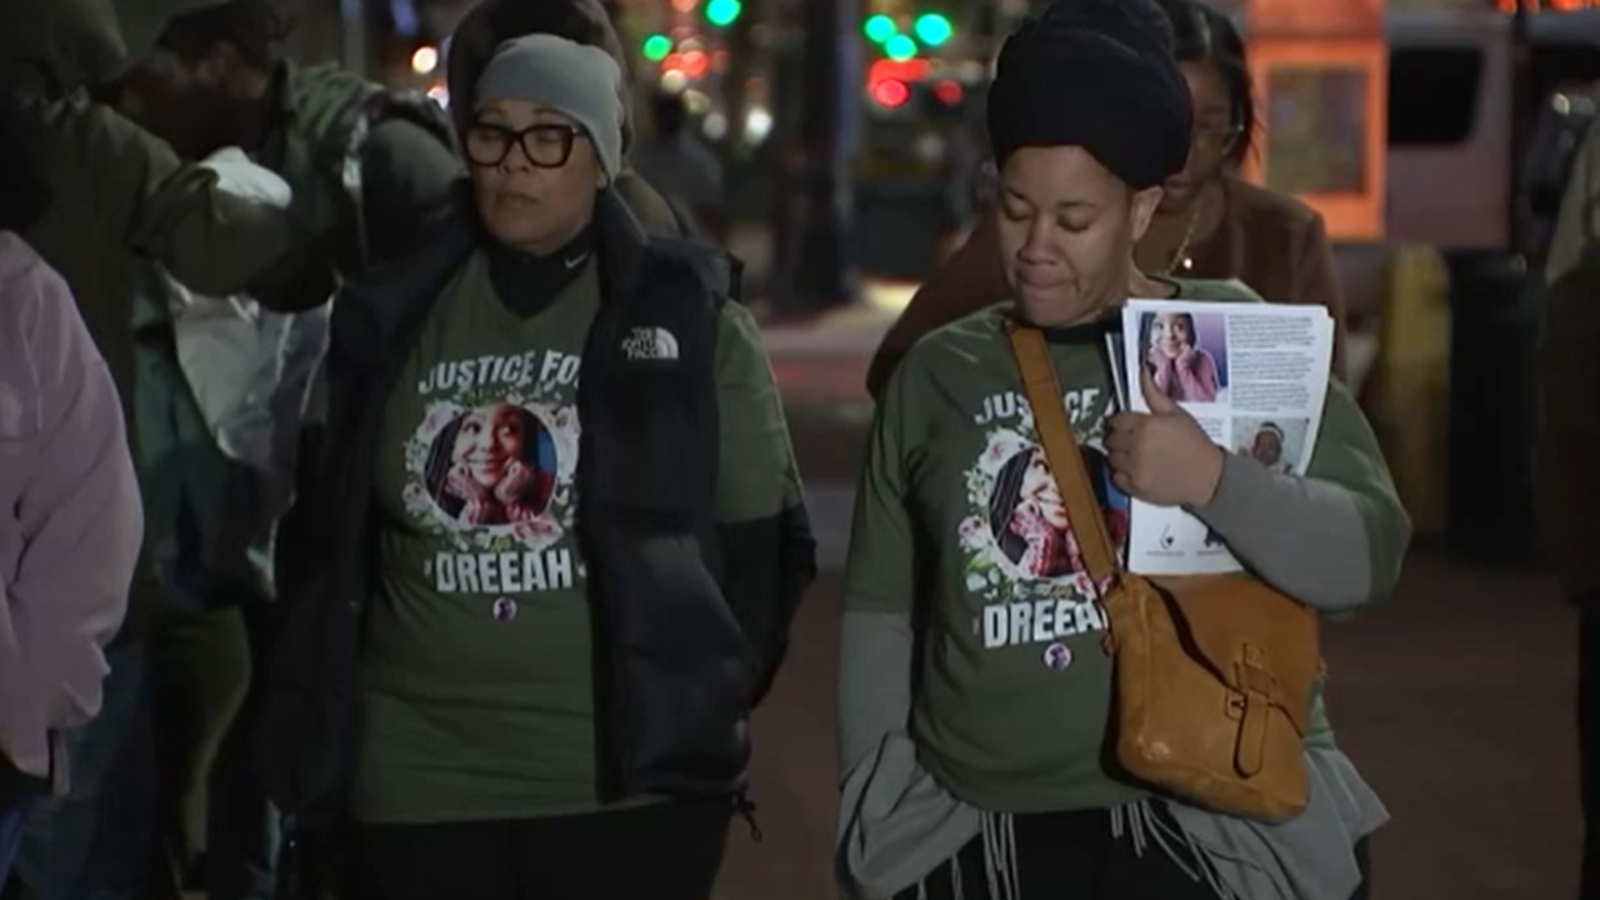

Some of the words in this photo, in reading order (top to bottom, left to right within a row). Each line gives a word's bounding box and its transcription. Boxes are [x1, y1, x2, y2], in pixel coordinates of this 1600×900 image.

[418, 351, 535, 394] JUSTICE
[539, 349, 580, 390] FO
[974, 388, 1100, 424] JUSCE
[436, 549, 573, 593] DREEAH
[983, 597, 1108, 649] DREEA
